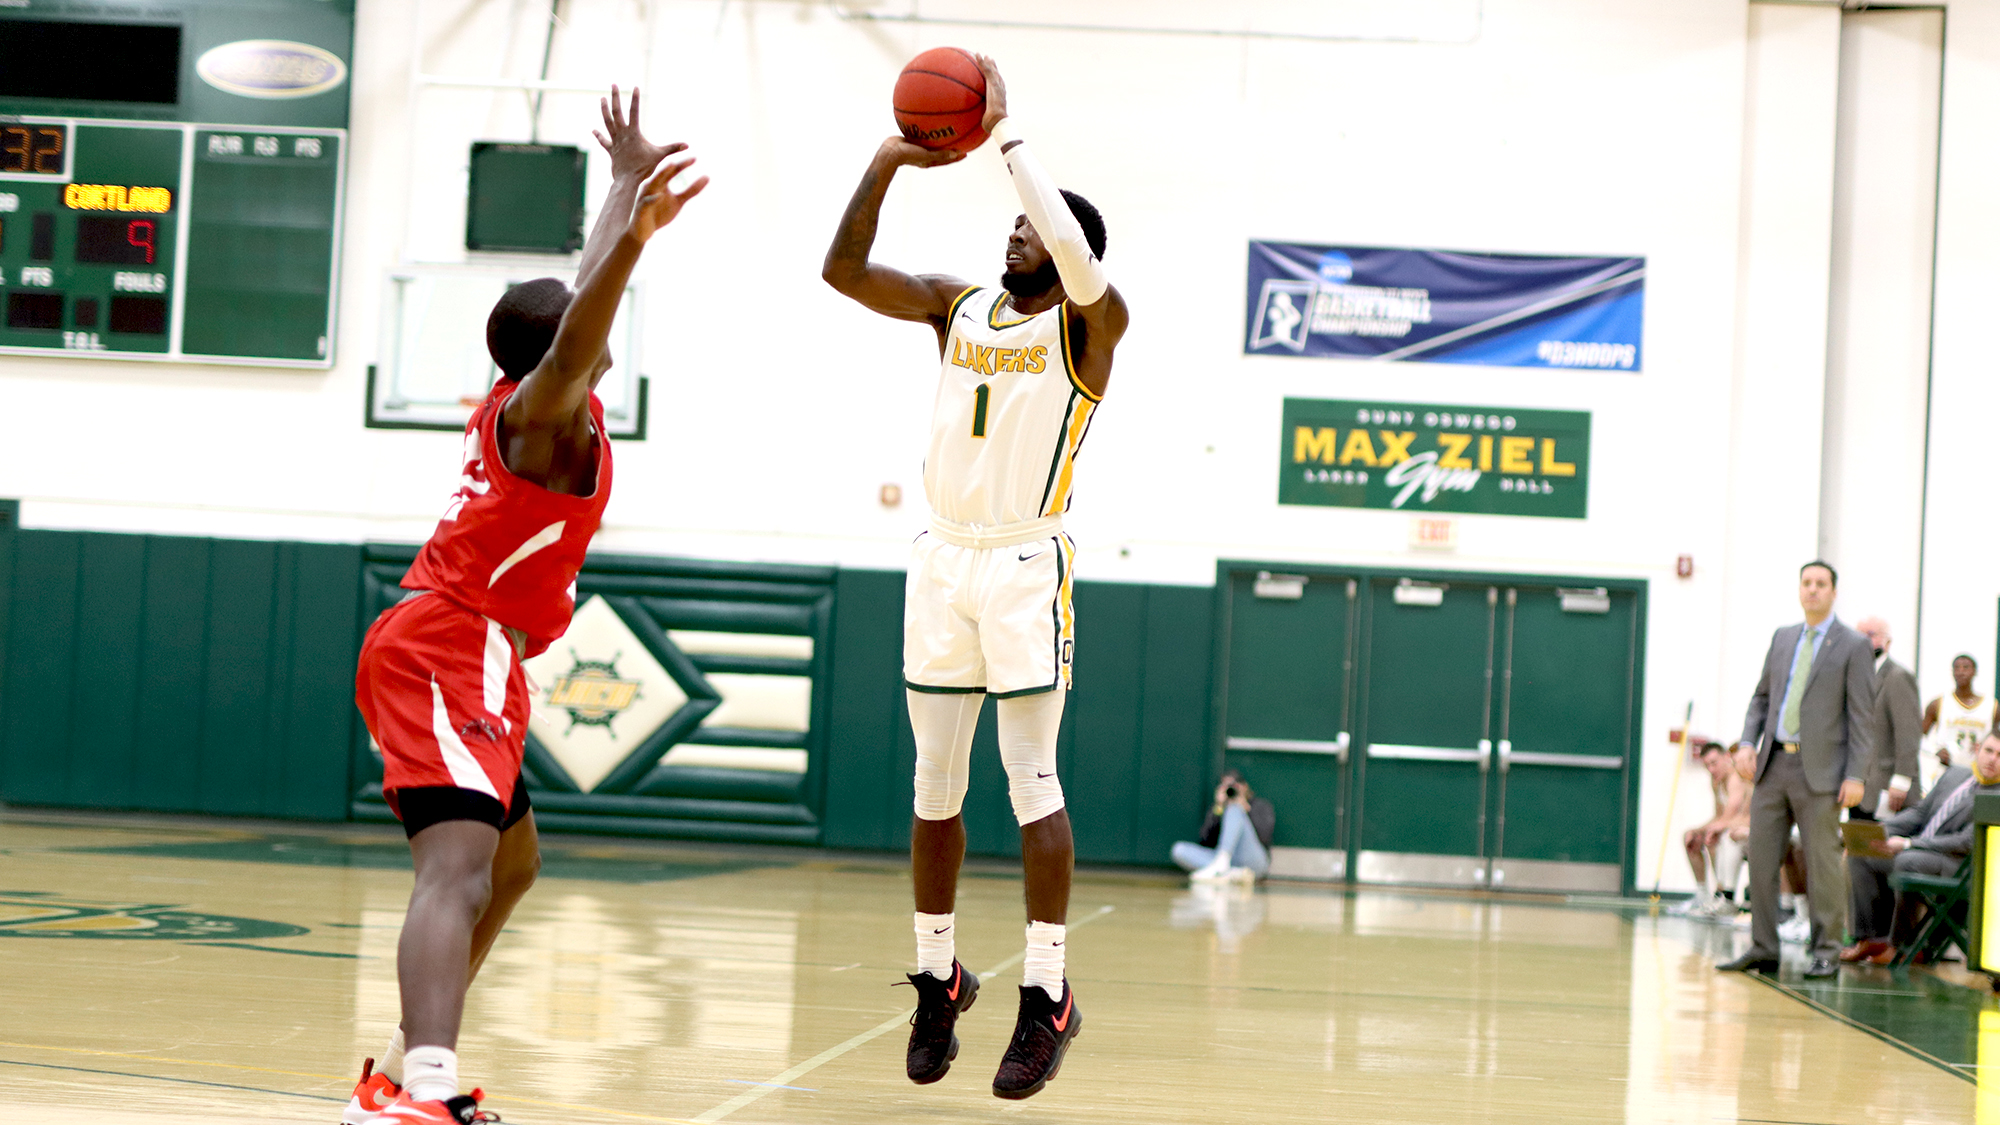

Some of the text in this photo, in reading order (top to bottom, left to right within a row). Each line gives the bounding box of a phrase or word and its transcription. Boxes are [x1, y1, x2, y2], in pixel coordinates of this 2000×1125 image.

[65, 183, 171, 213] CORTLAND
[127, 219, 155, 263] 9
[21, 266, 54, 287] PTS
[113, 271, 167, 293] FOULS
[1314, 293, 1432, 323] BASKETBALL
[1310, 314, 1412, 337] CHAMPIONSHIP
[951, 336, 1048, 376] LAKERS
[970, 381, 992, 439] 1
[1355, 409, 1517, 430] SUNY OSWEGO
[1294, 426, 1577, 477] MAX ZIEL
[1384, 451, 1481, 508] Gym
[1499, 477, 1554, 494] HALL
